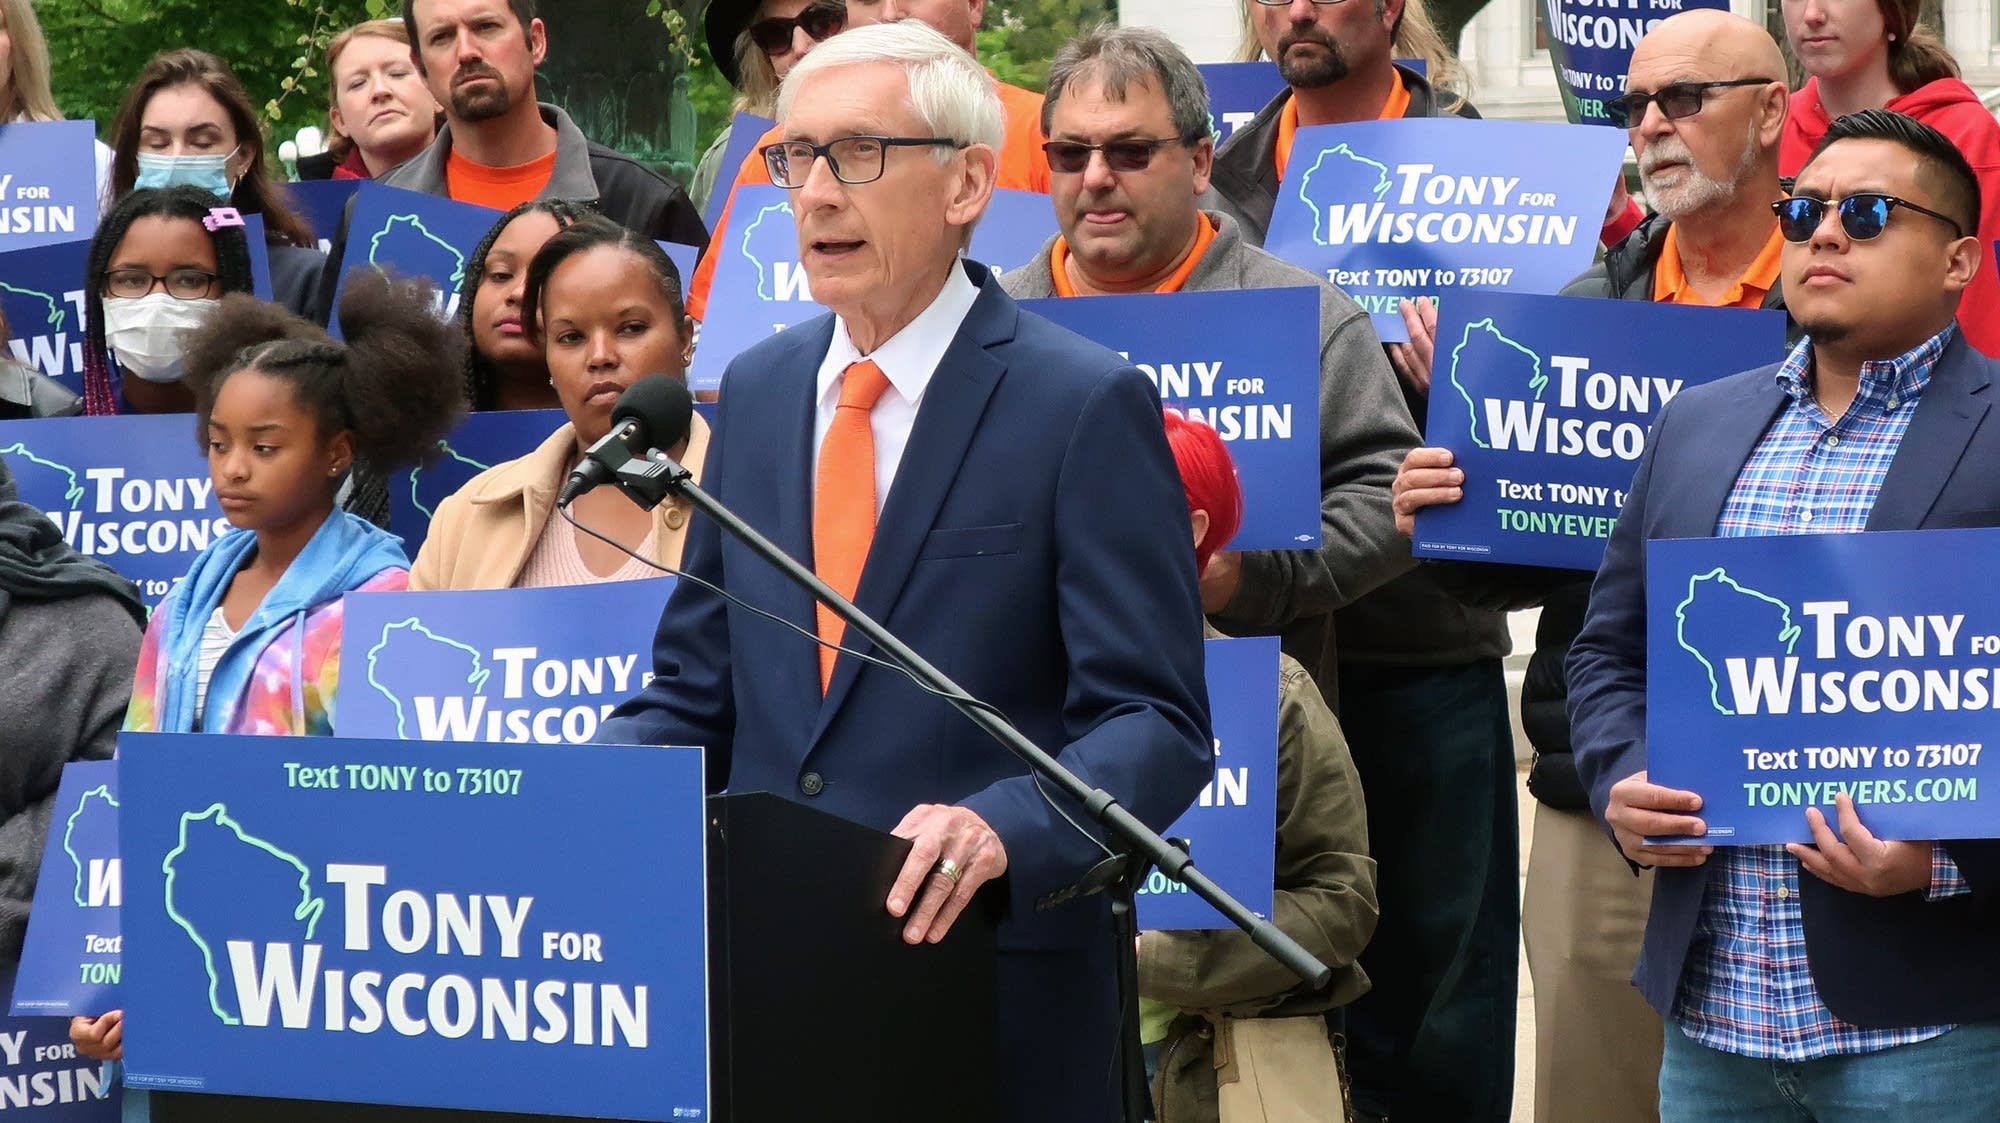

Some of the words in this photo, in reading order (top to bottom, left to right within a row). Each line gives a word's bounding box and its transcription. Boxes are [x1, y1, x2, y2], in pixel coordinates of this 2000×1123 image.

[1595, 74, 1614, 91] to
[17, 186, 50, 199] FOR
[1396, 164, 1520, 206] TONY
[1519, 192, 1556, 207] FOR
[1329, 202, 1577, 245] WISCONSIN
[1327, 269, 1370, 286] Text
[1375, 269, 1432, 287] TONY
[1435, 271, 1456, 286] to
[1460, 268, 1513, 285] 73107
[1118, 351, 1222, 398] NY
[1226, 378, 1265, 395] FOR
[1551, 356, 1684, 413] TONY
[1485, 398, 1650, 460] WISCO
[86, 468, 213, 513] TONY
[1497, 479, 1543, 501] Text
[1547, 483, 1609, 506] TONY
[1614, 489, 1628, 507] t
[1803, 601, 1965, 659] TONY
[493, 647, 638, 698] TONY
[414, 696, 615, 744] WISCO
[1743, 748, 1798, 769] Text
[1804, 747, 1877, 768] TONY
[1883, 747, 1910, 767] to
[1916, 744, 1982, 766] 73107
[284, 763, 339, 788] Text
[345, 765, 417, 791] TONY
[423, 768, 450, 792] to
[456, 768, 523, 794] 73107
[1743, 778, 1977, 806] TONYEVERS.COM
[326, 863, 534, 958] TONY
[542, 932, 603, 962] FOR
[85, 935, 122, 953] Text
[226, 940, 648, 1048] WISCONSIN
[34, 1043, 76, 1062] FOR
